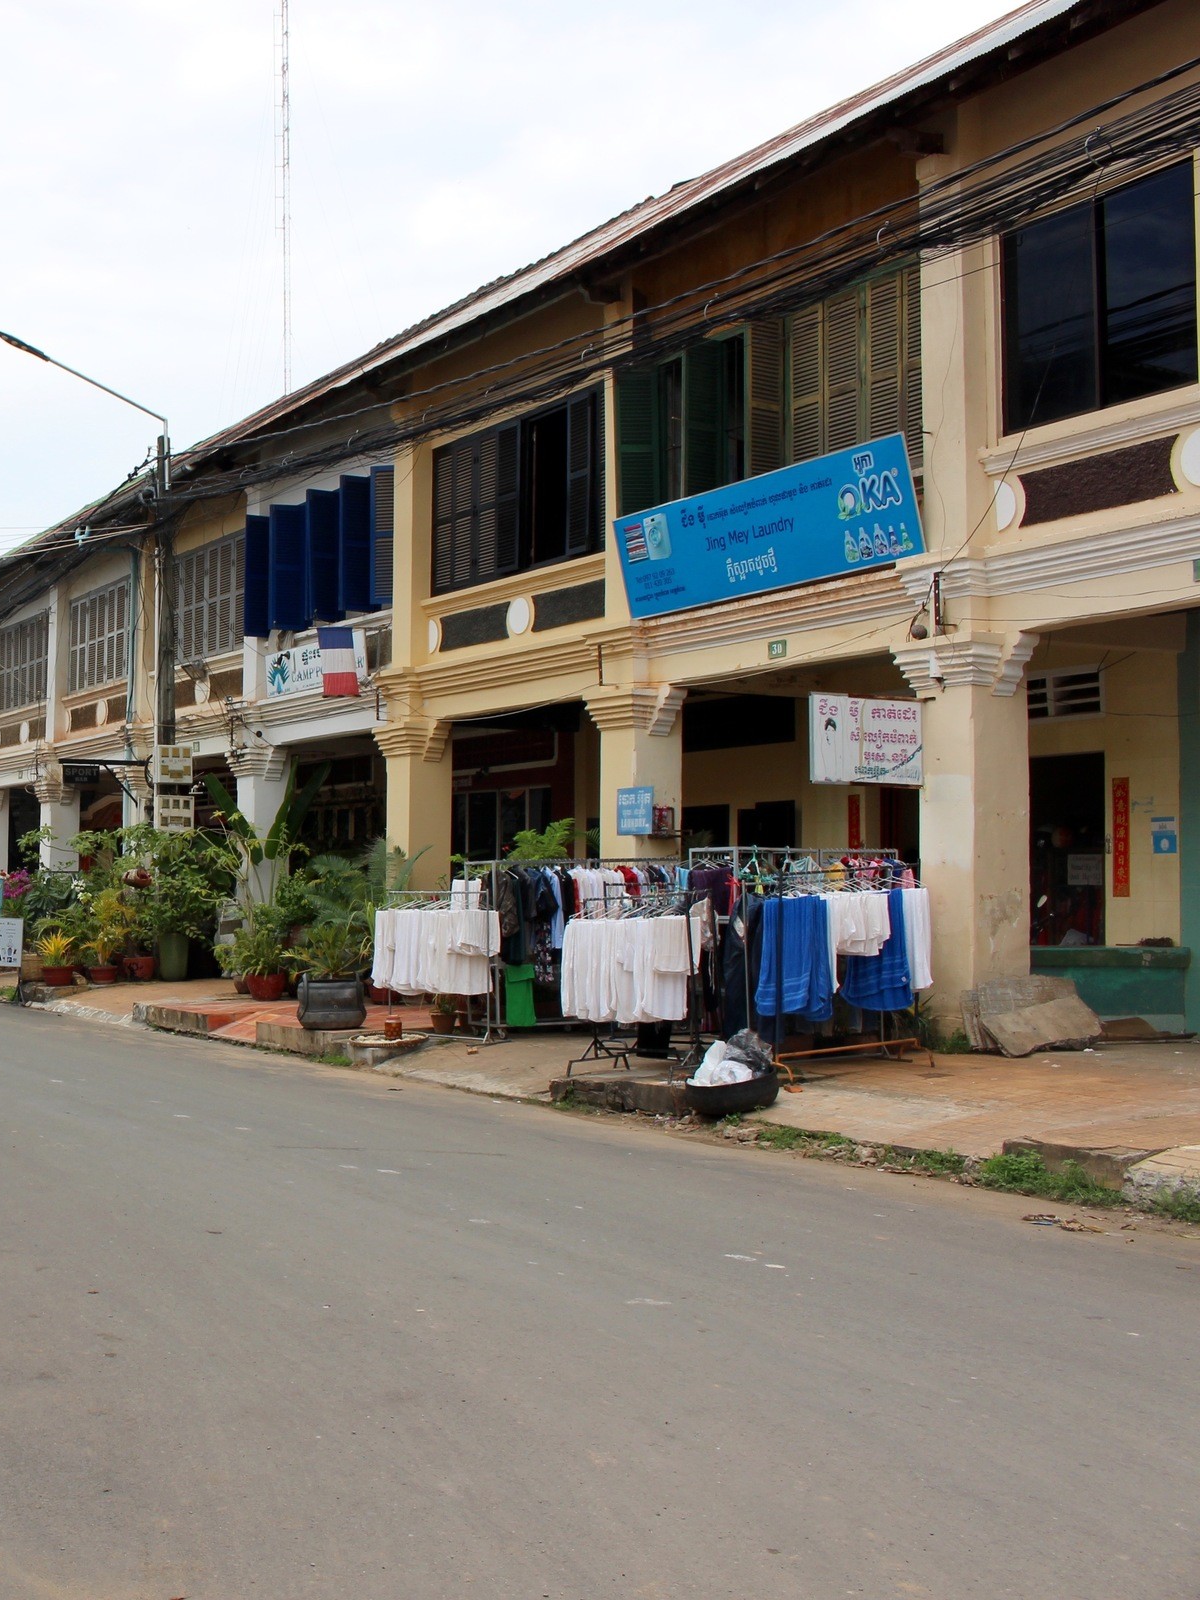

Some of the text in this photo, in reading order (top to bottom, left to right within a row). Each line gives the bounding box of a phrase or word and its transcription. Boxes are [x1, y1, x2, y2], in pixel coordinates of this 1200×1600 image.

[838, 470, 902, 520] OKA
[706, 517, 794, 551] Jing Mey Laundry
[771, 643, 783, 655] 30
[65, 767, 99, 776] SPORT
